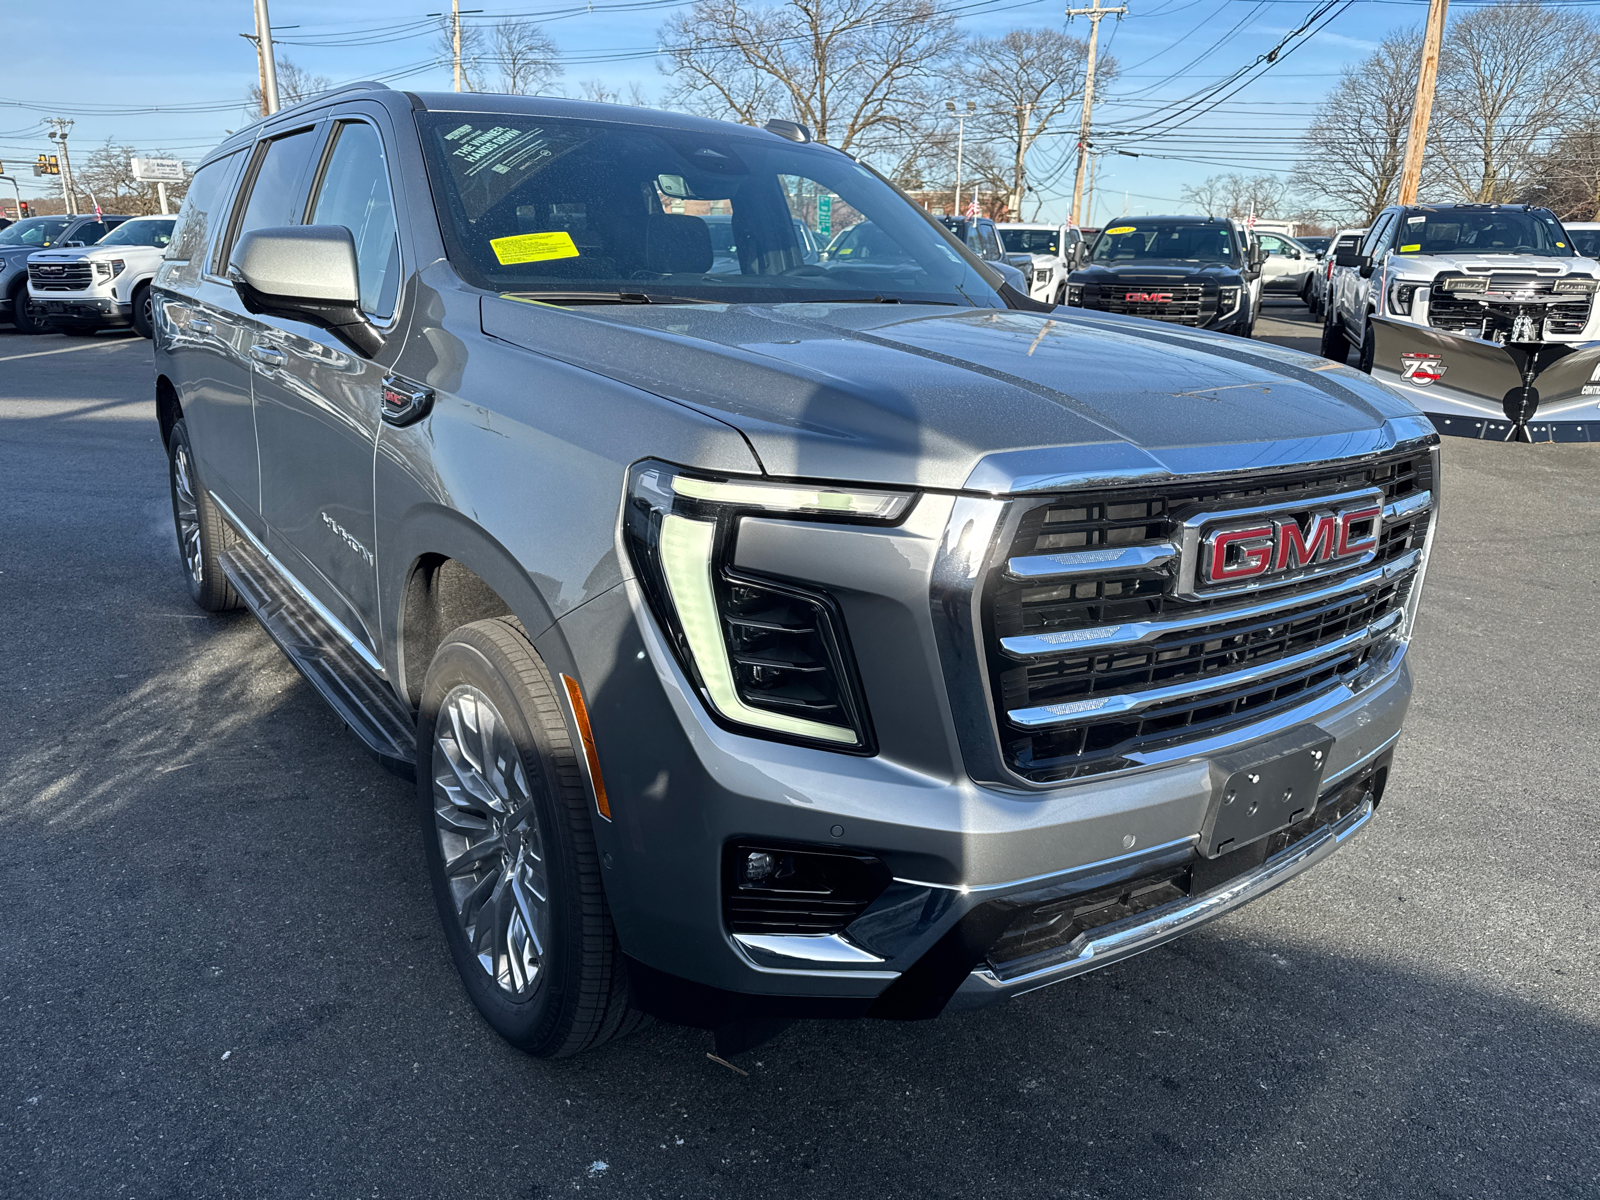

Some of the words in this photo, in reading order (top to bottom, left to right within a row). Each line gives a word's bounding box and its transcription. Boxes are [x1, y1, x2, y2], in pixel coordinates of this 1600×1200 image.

[452, 143, 477, 157] THE
[464, 142, 499, 163] HANDS
[494, 128, 522, 145] DOWN
[1125, 292, 1174, 303] GMC
[385, 390, 402, 406] GMC
[1205, 506, 1381, 583] GMC
